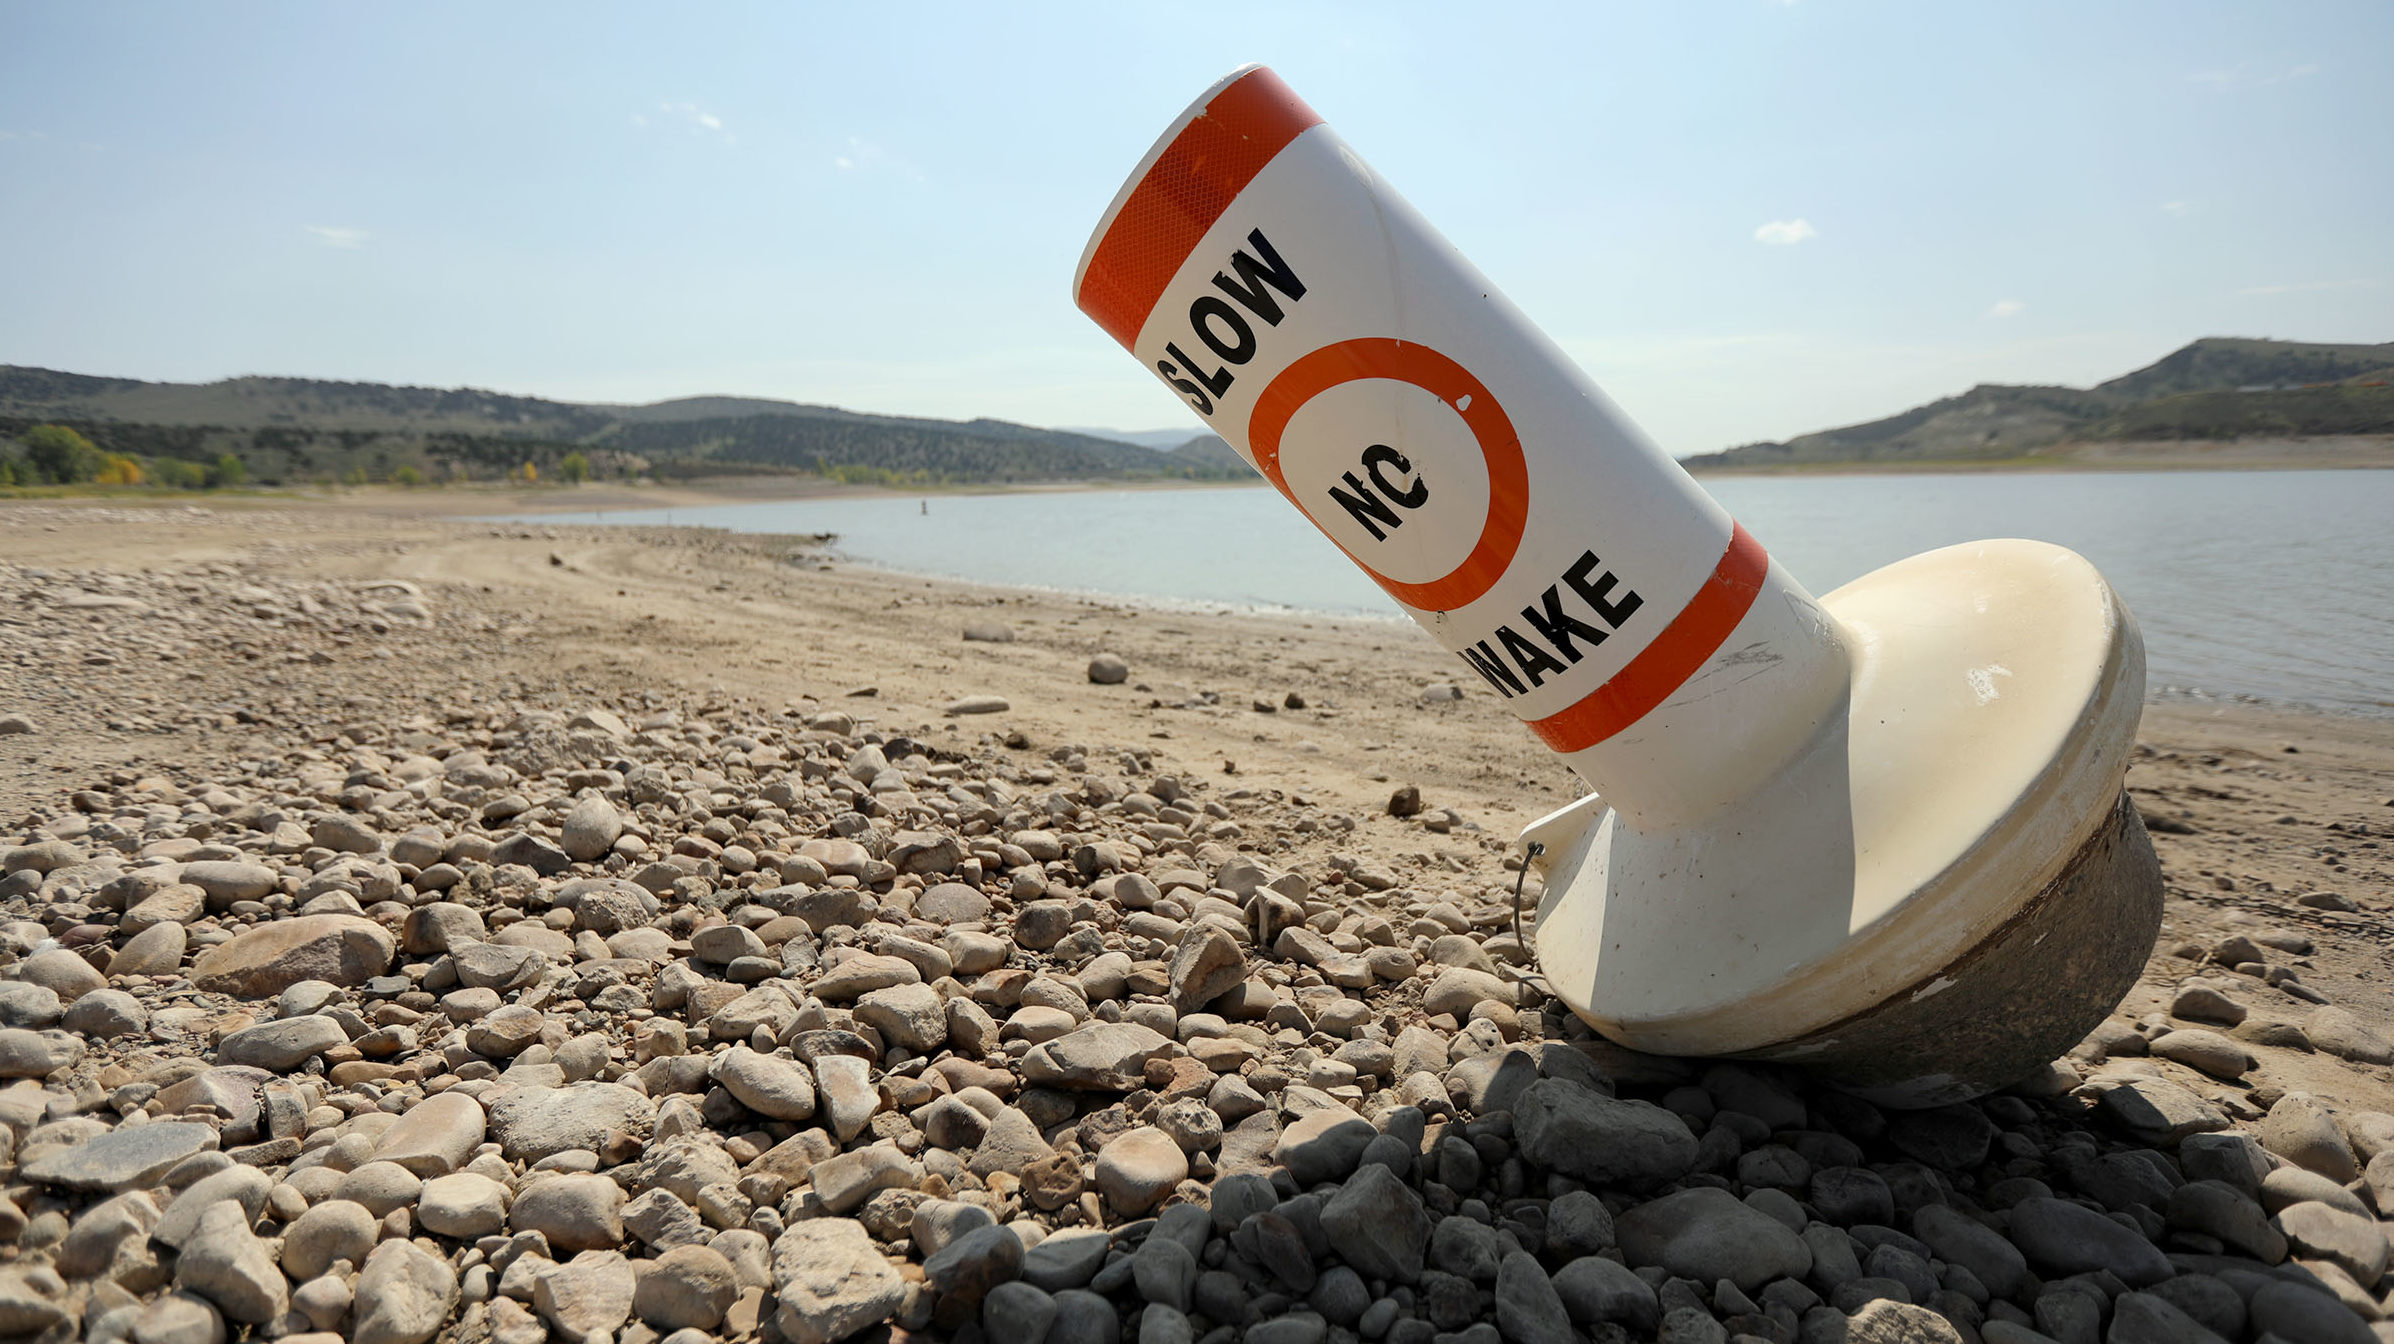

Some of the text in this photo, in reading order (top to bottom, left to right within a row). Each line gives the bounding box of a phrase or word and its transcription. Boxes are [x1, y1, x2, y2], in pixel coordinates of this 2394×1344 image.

[1157, 227, 1307, 415] SLOW
[1328, 444, 1428, 542] NO
[1456, 549, 1644, 698] WAKE
